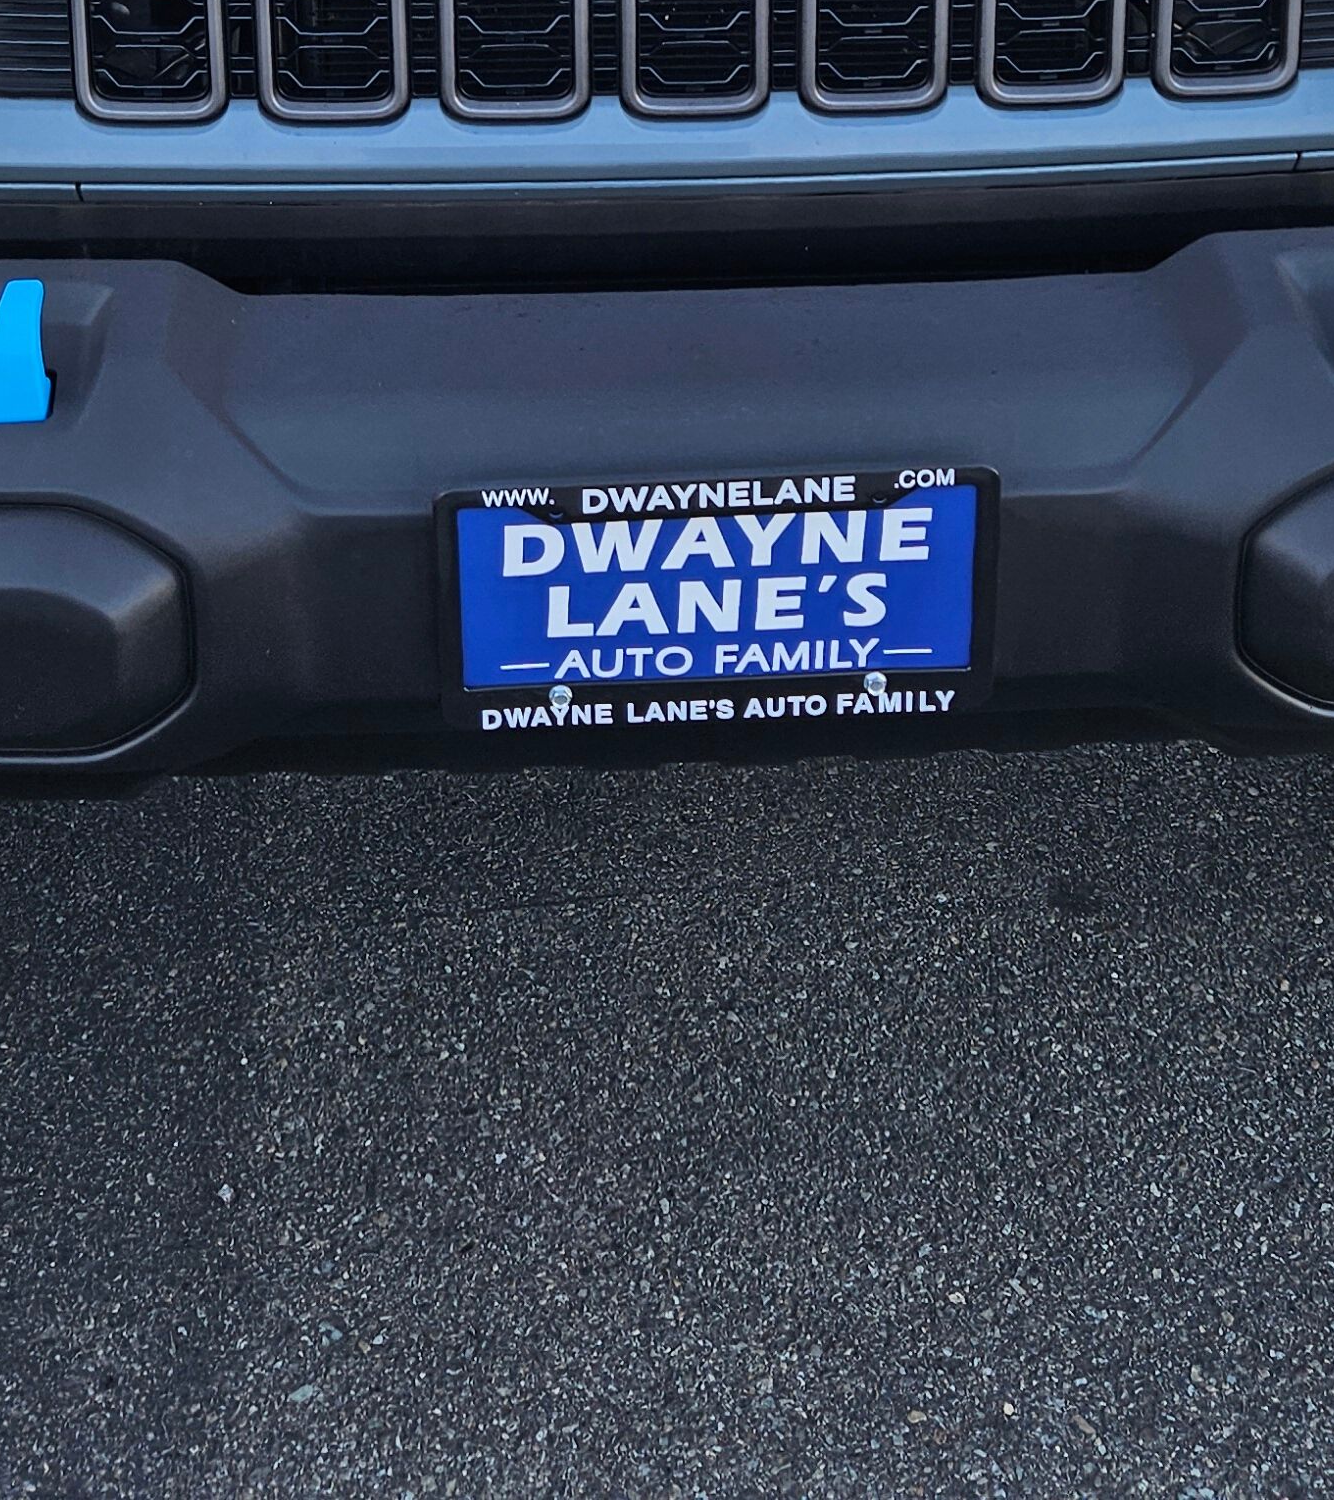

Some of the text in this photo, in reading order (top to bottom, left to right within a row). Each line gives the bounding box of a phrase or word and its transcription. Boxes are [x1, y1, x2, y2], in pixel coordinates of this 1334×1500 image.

[481, 468, 956, 515] WWW. DWAYNELANE .COM
[502, 507, 933, 578] DWAYNE
[547, 572, 888, 639] LANE'S
[554, 637, 880, 680] AUTO FAMILY
[481, 689, 956, 731] DWAYNE LANE'S AUTO FAMILY
